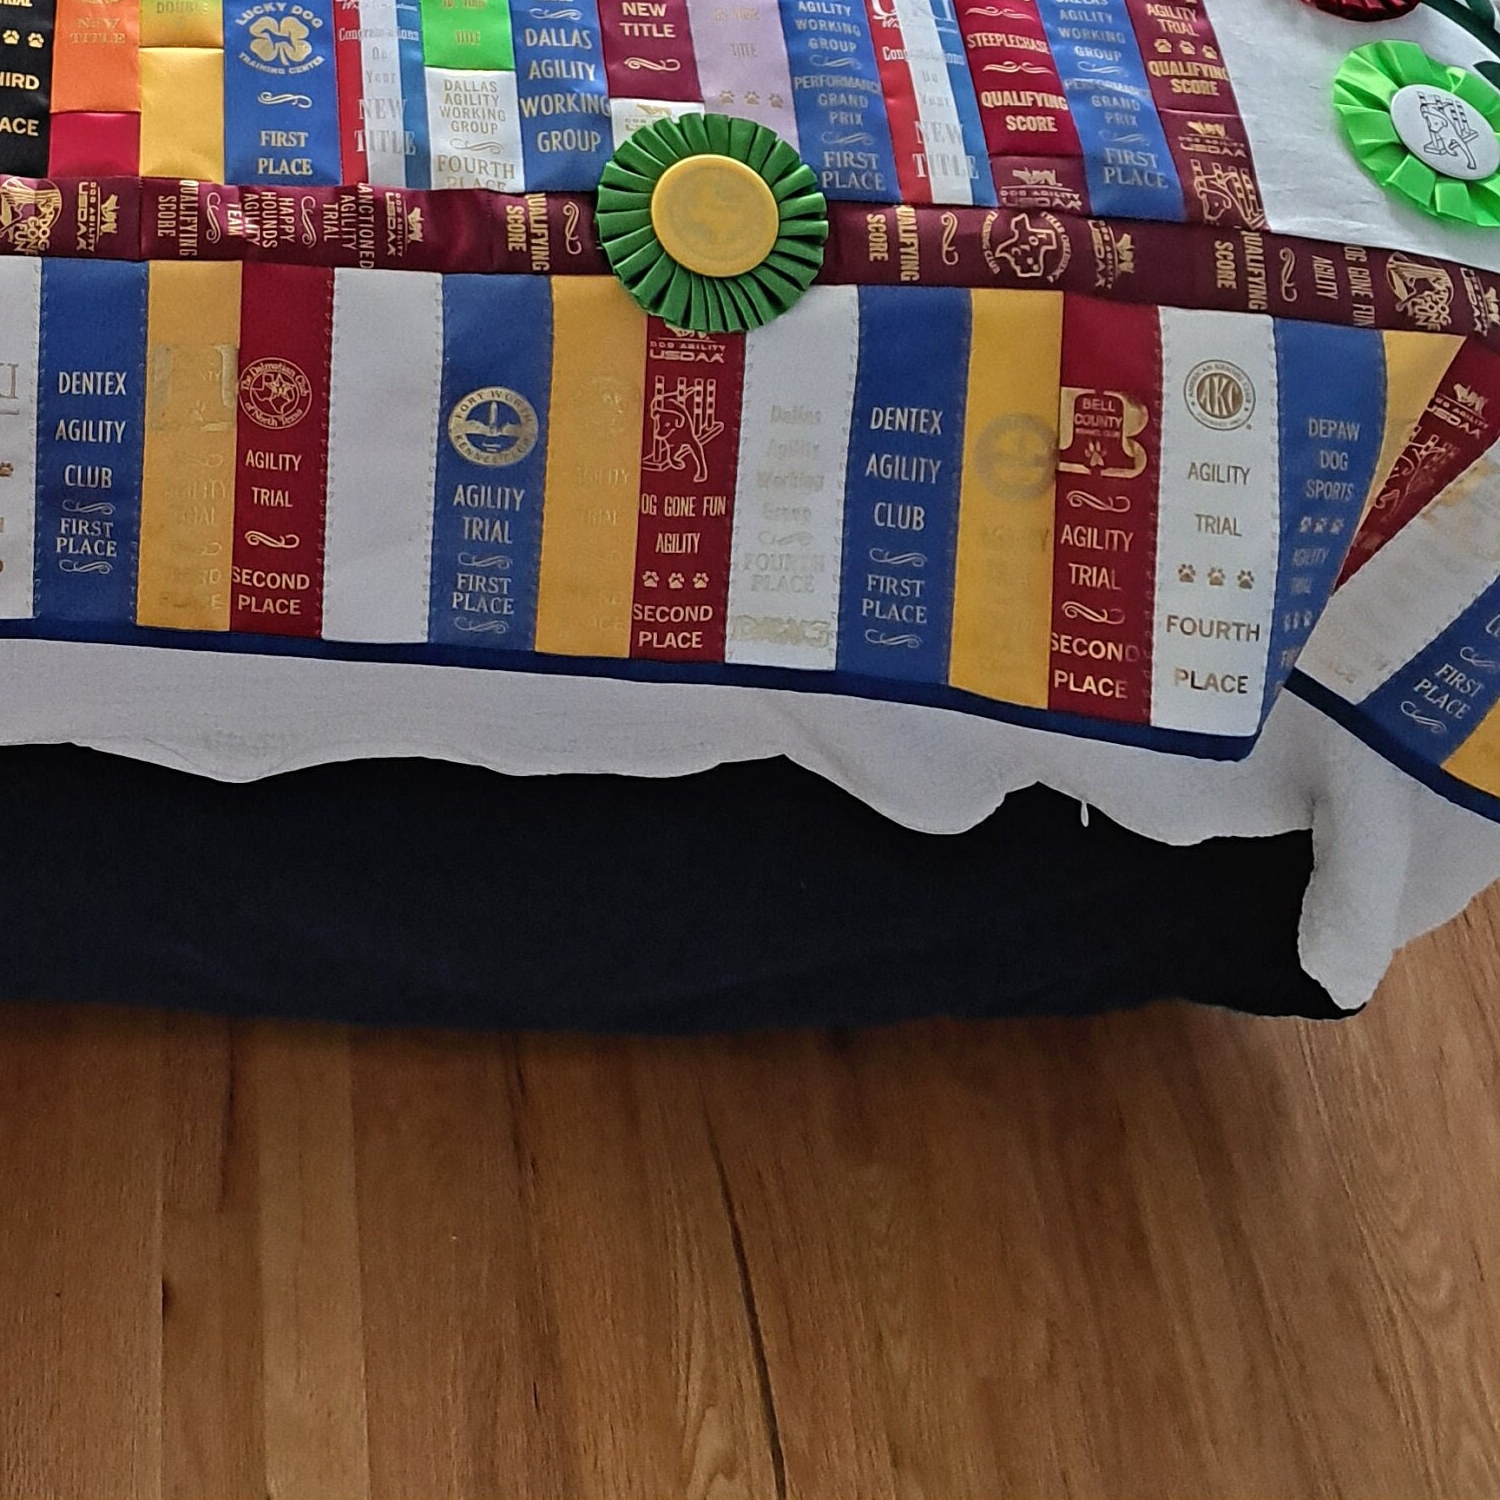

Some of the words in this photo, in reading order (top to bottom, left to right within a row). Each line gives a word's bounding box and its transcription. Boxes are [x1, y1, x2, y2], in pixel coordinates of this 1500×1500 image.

[235, 2, 287, 25] LUCKY
[291, 4, 324, 28] DOG
[981, 91, 1069, 111] QUALIFYING
[1006, 115, 1059, 132] SCORE
[260, 191, 278, 249] HOUNDS
[278, 197, 295, 242] HAPPY
[58, 371, 127, 396] DENTEX
[252, 410, 278, 428] North
[870, 406, 944, 436] DENTEX
[1308, 418, 1360, 442] DEPAW
[59, 518, 114, 538] FIRST
[1166, 615, 1261, 642] FOURTH
[1173, 668, 1249, 694] PLACE
[1433, 662, 1485, 697] FIRST
[1412, 677, 1471, 720] PLACE
